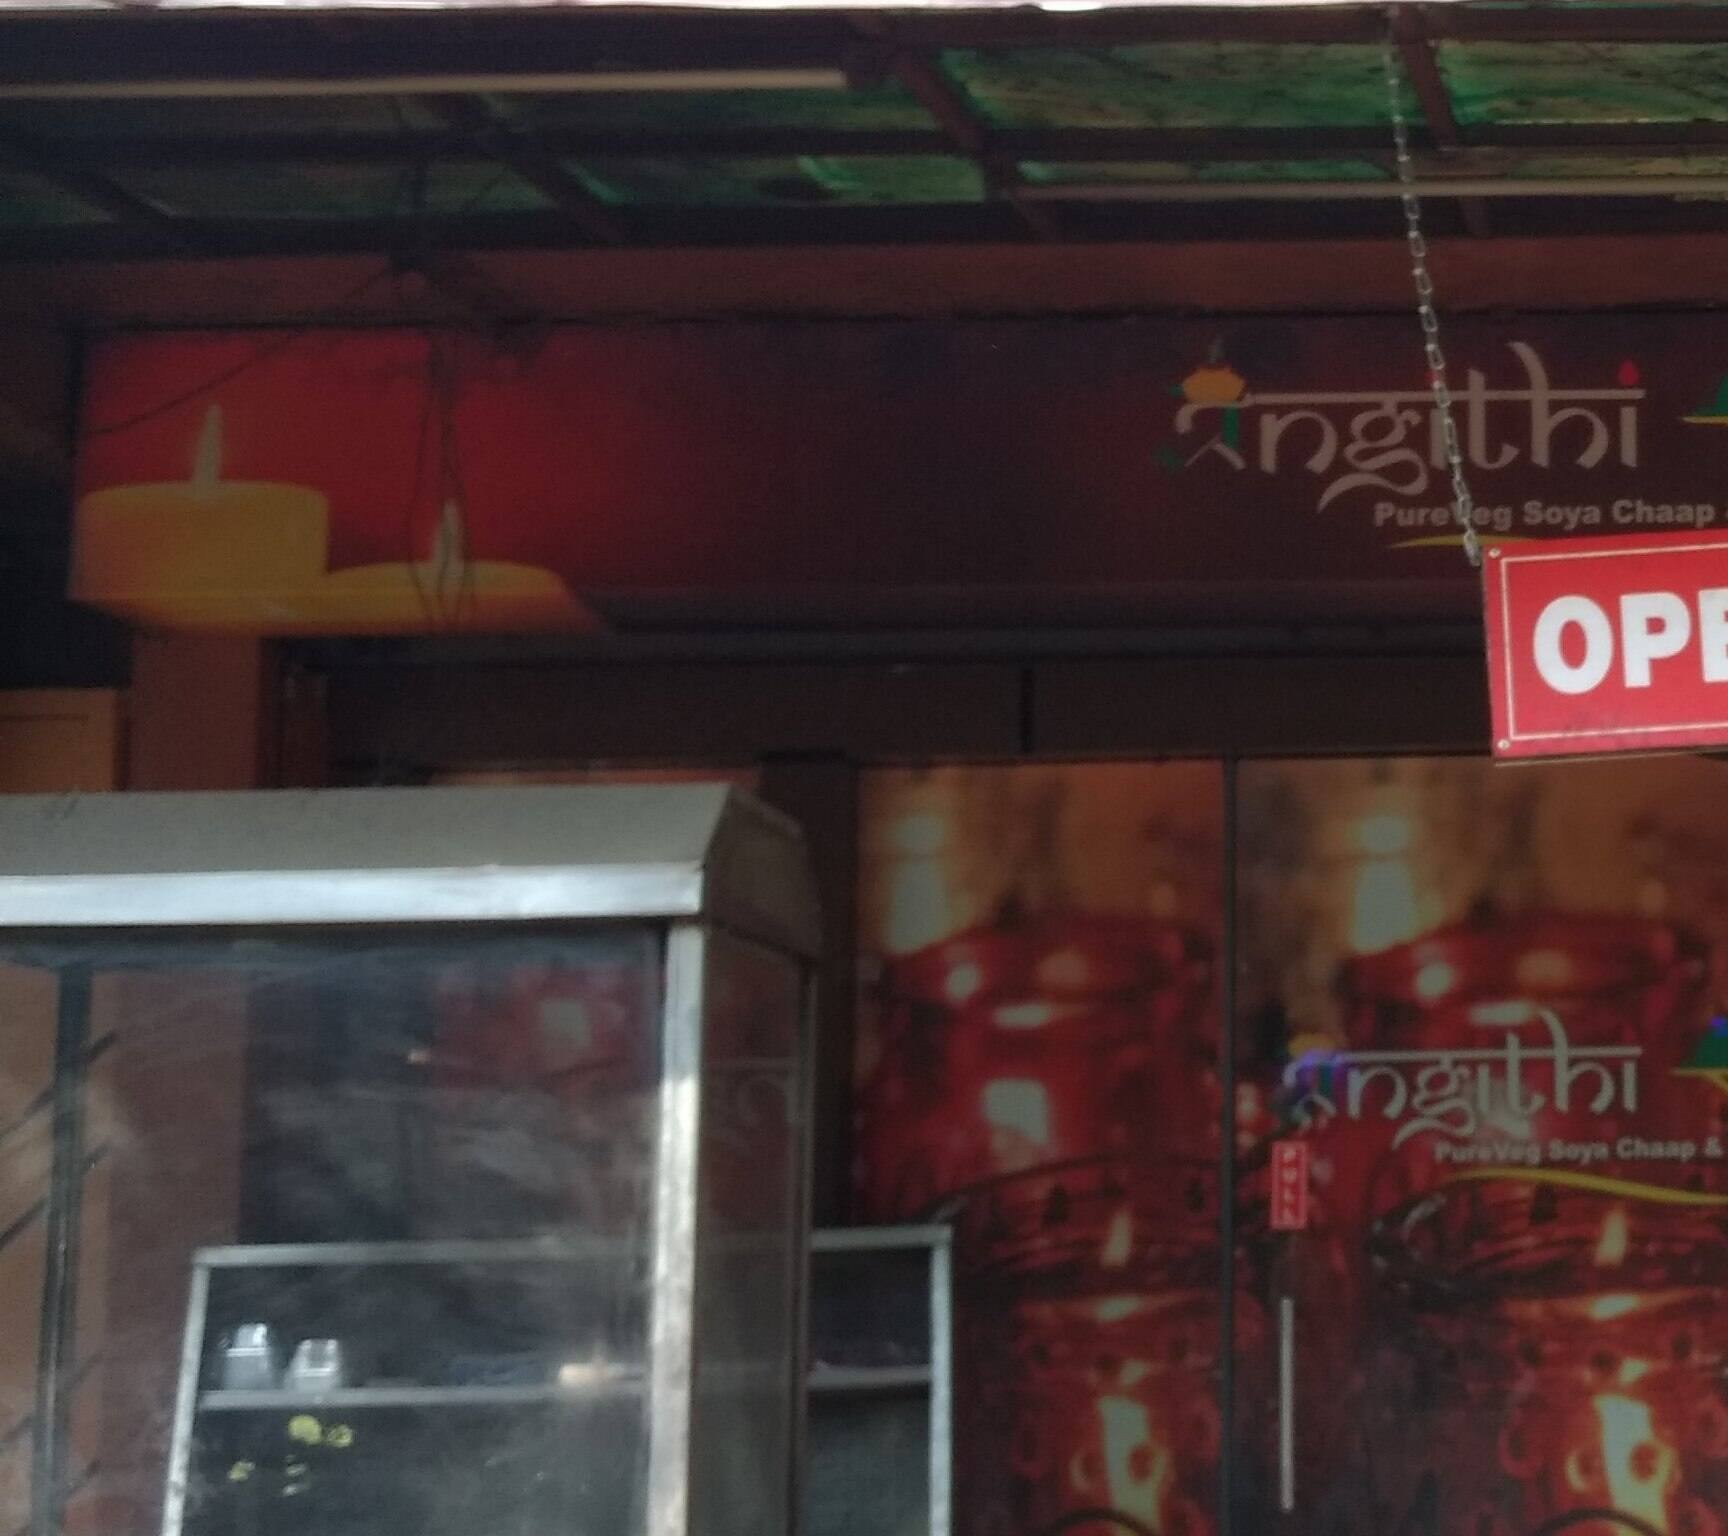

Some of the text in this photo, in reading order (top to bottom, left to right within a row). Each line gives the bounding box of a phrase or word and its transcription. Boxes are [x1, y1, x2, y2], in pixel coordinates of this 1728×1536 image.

[1523, 499, 1600, 531] Soya
[1612, 497, 1715, 528] Chaap
[1704, 1137, 1723, 1157] &
